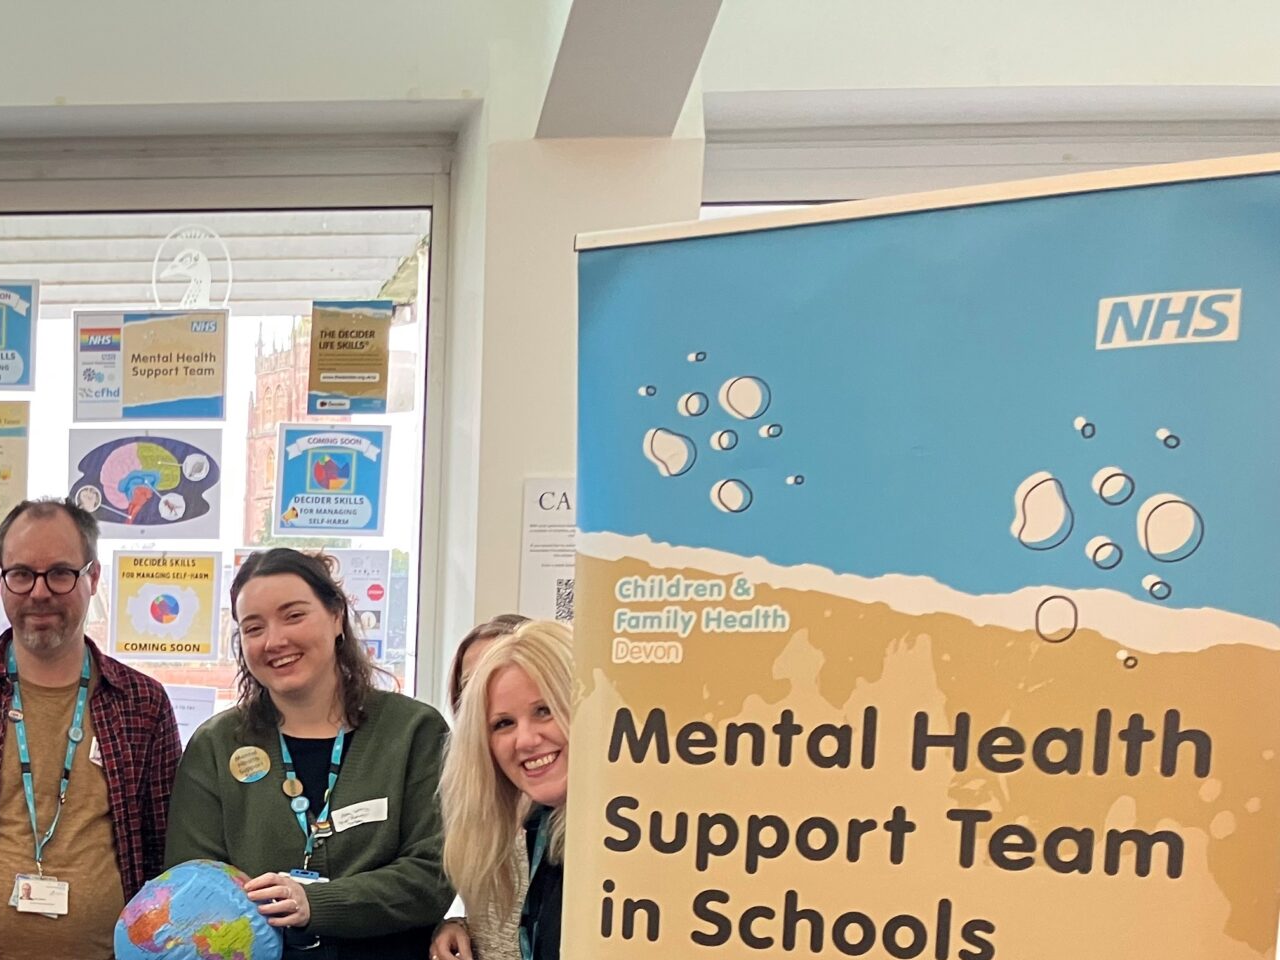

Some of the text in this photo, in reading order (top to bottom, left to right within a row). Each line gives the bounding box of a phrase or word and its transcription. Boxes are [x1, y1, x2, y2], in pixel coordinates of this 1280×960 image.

[1100, 293, 1236, 345] NHS
[192, 322, 216, 332] NHS
[320, 330, 375, 338] THE DECIDER
[88, 336, 112, 345] NHS
[319, 341, 334, 350] LIFE
[131, 352, 216, 363] Mental Health
[132, 366, 215, 378] Support Team
[94, 388, 120, 398] cfhd
[294, 496, 364, 505] DECIDER SKILLS
[133, 558, 196, 567] DECIDER SKILLS
[618, 577, 752, 600] Children &
[616, 608, 787, 635] Family Health
[124, 643, 200, 652] COMING SOON
[614, 640, 680, 661] Devon
[608, 706, 1213, 778] Mental Health
[604, 796, 1185, 879] Support Team
[601, 880, 660, 942] in
